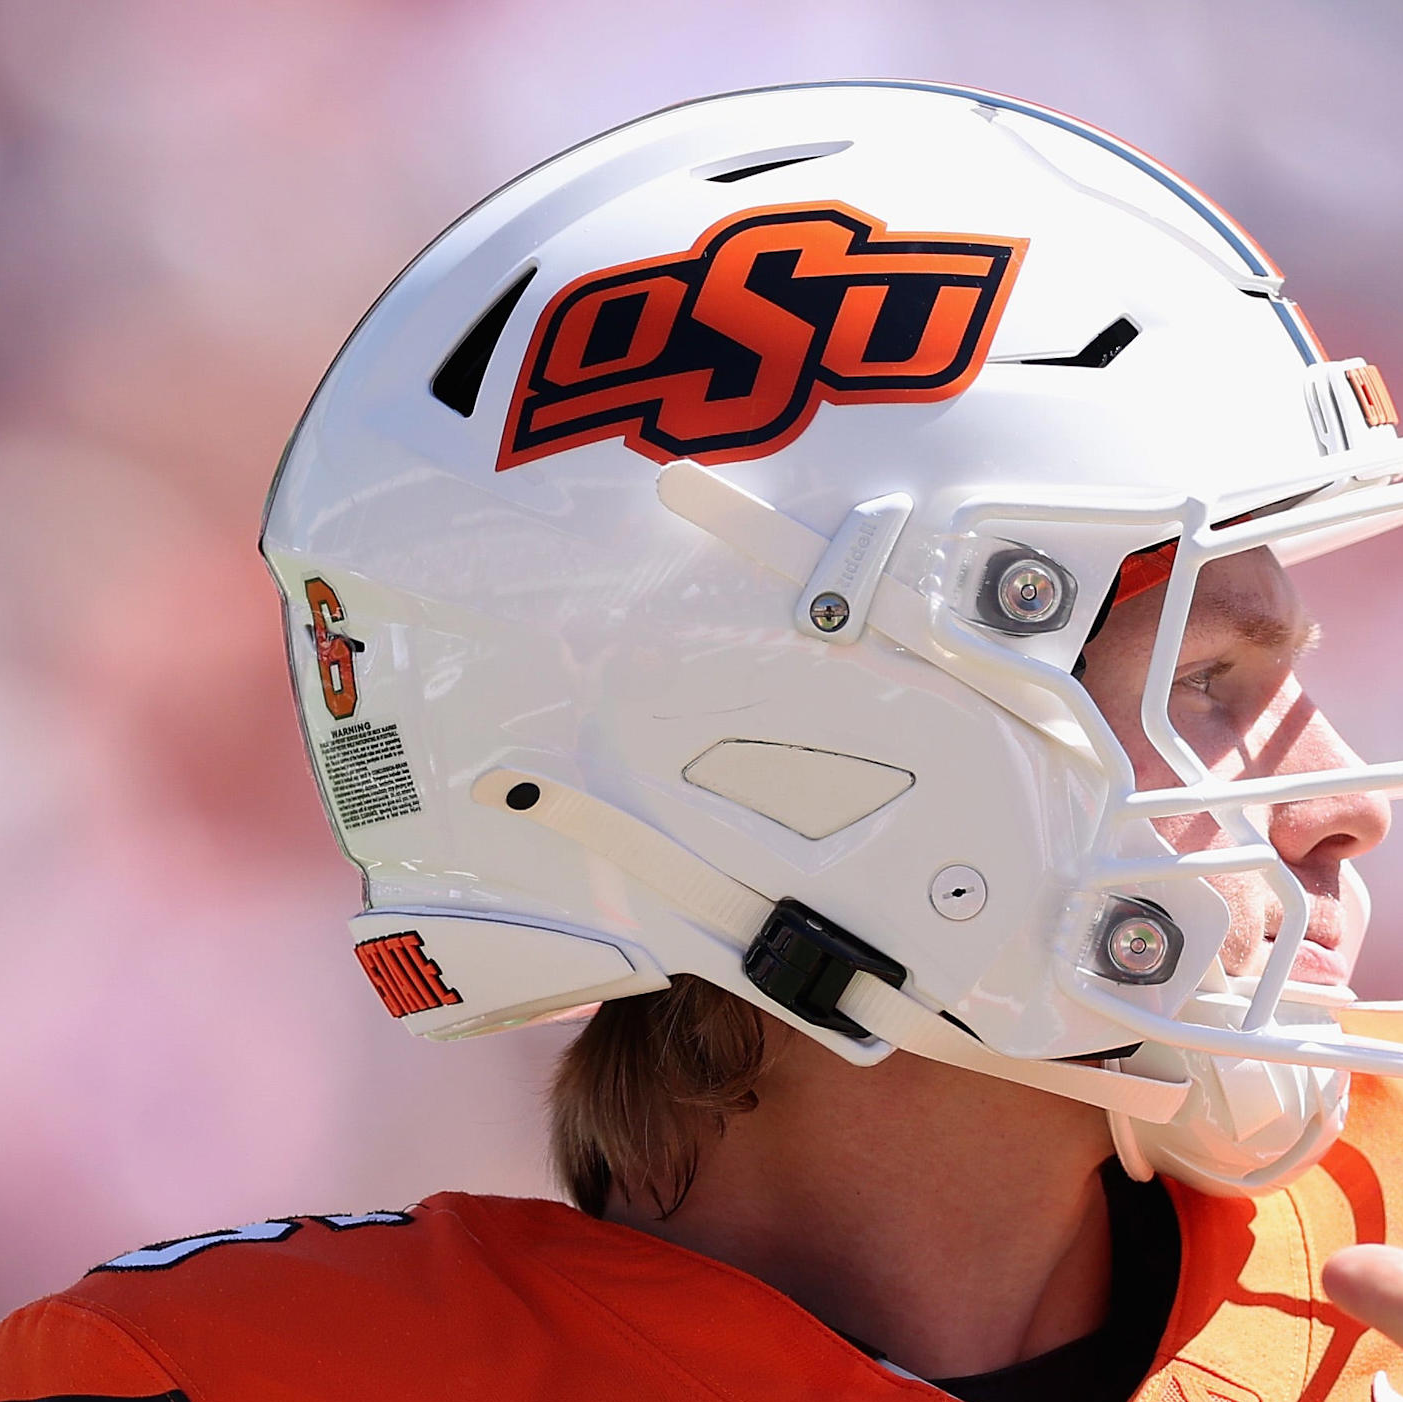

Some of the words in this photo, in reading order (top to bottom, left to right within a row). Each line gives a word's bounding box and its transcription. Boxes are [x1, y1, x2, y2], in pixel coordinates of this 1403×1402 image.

[304, 577, 358, 721] 6
[331, 721, 372, 739] WARNING
[354, 930, 464, 1019] STATE
